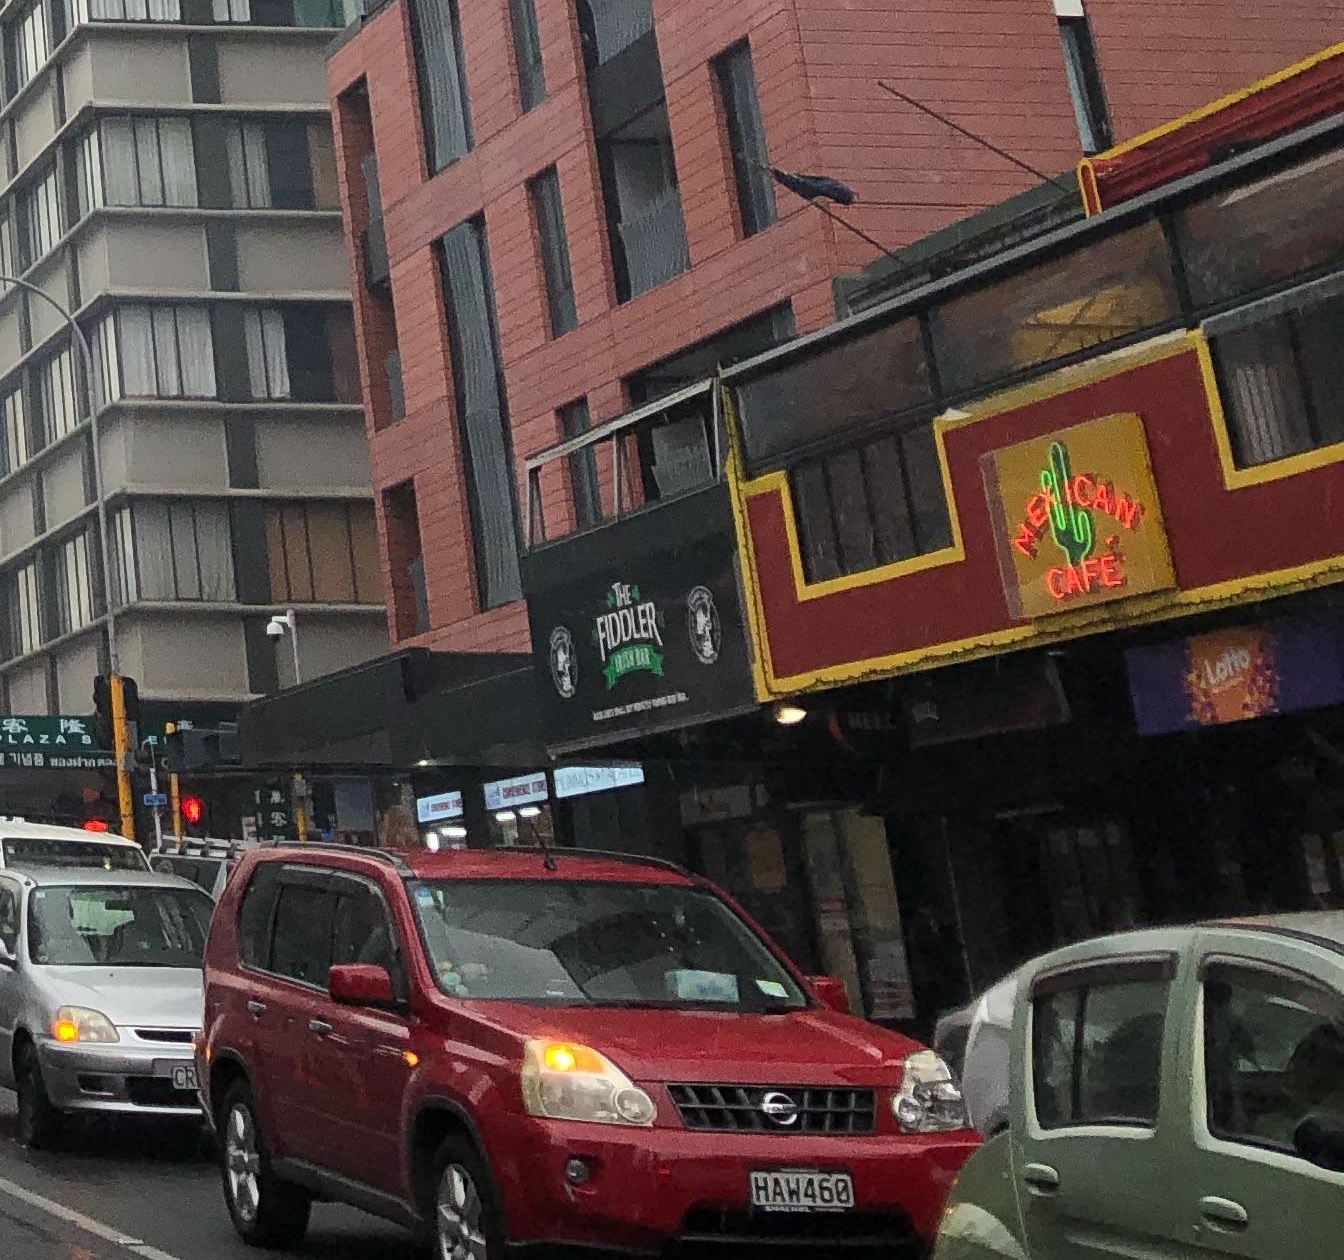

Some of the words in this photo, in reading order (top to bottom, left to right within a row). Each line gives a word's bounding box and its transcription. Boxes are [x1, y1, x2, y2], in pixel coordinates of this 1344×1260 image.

[1013, 474, 1140, 556] MEXICAN
[611, 582, 632, 606] THE
[596, 602, 663, 662] FIDDLER
[754, 1177, 850, 1204] HAW460
